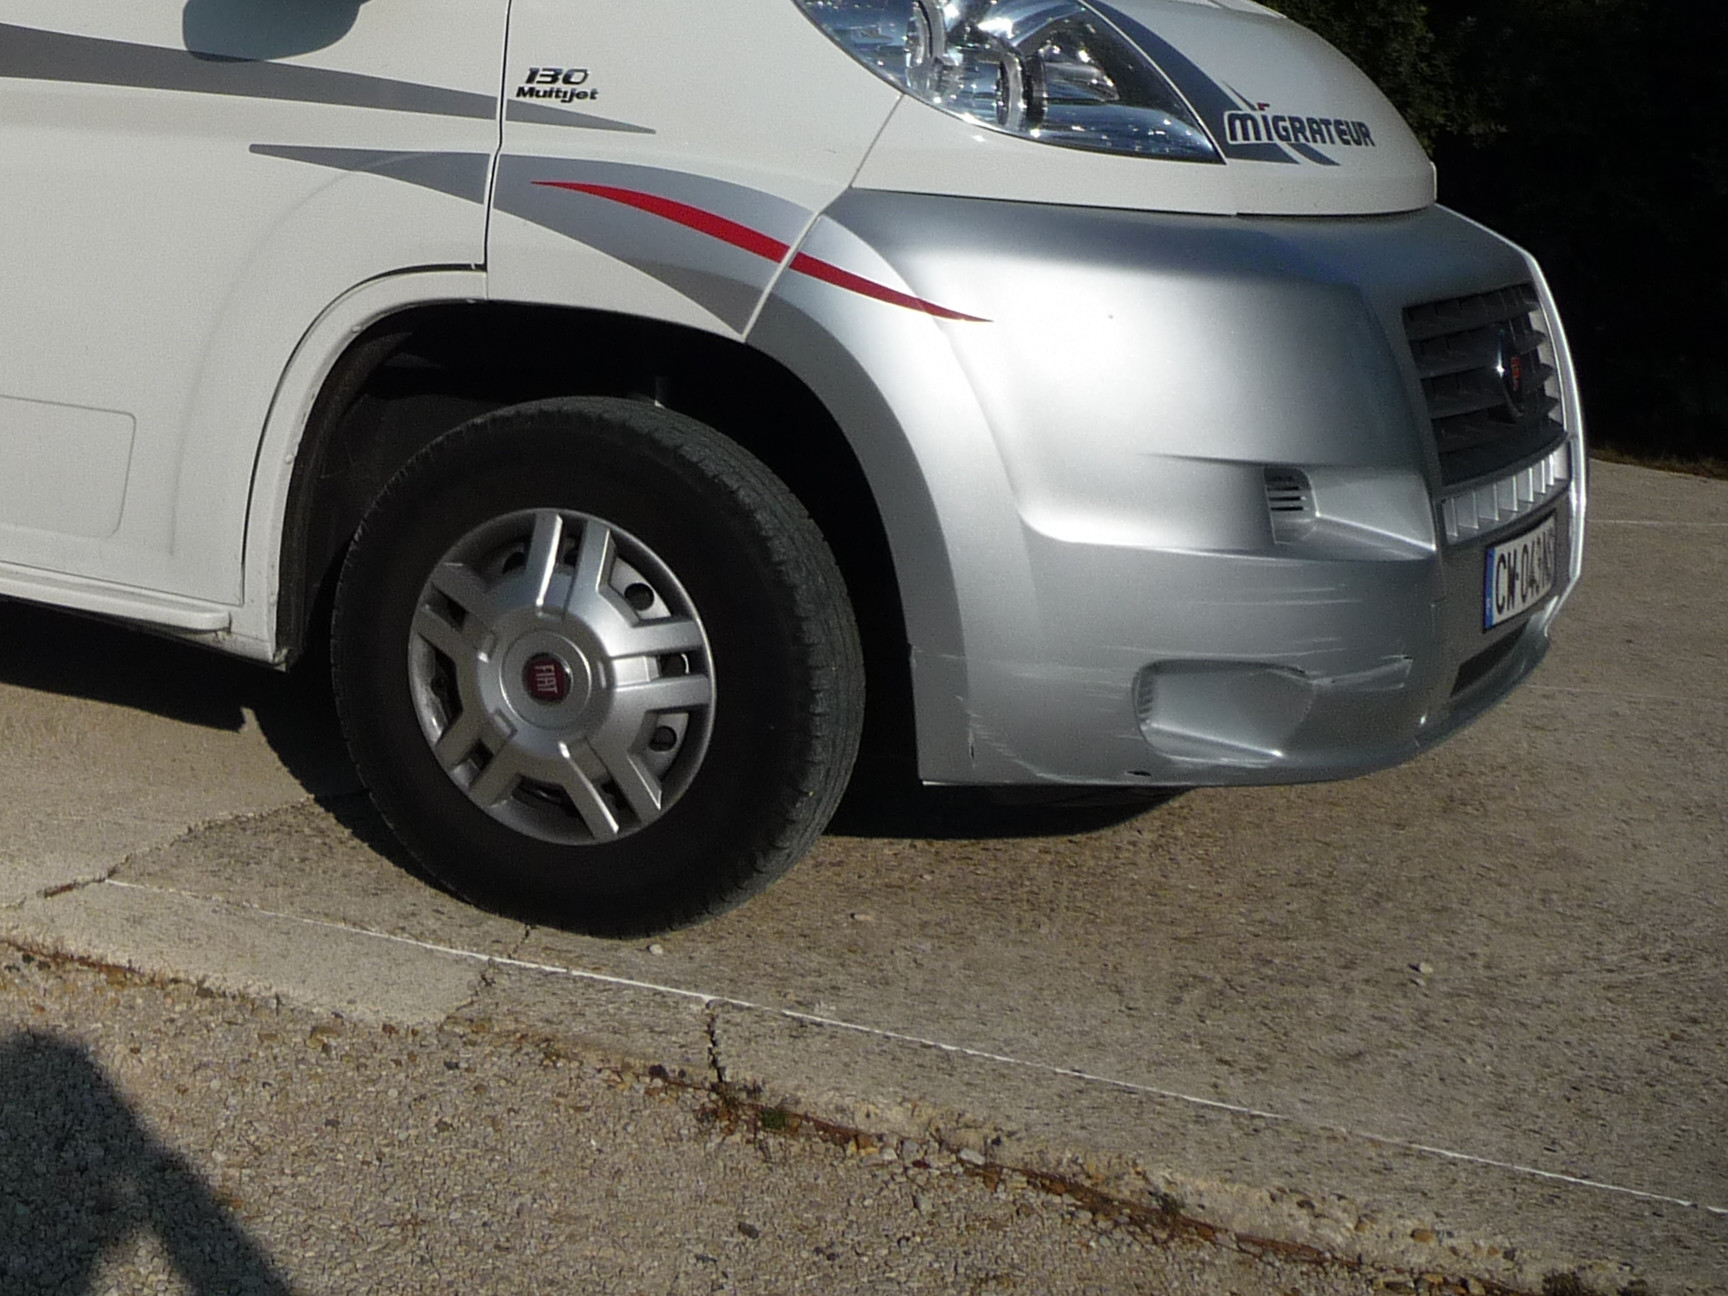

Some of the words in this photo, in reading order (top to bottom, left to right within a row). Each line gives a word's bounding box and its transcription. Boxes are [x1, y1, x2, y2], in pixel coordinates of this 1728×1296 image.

[524, 67, 590, 85] 130
[515, 86, 599, 103] Multijet
[534, 664, 558, 693] FIAT
